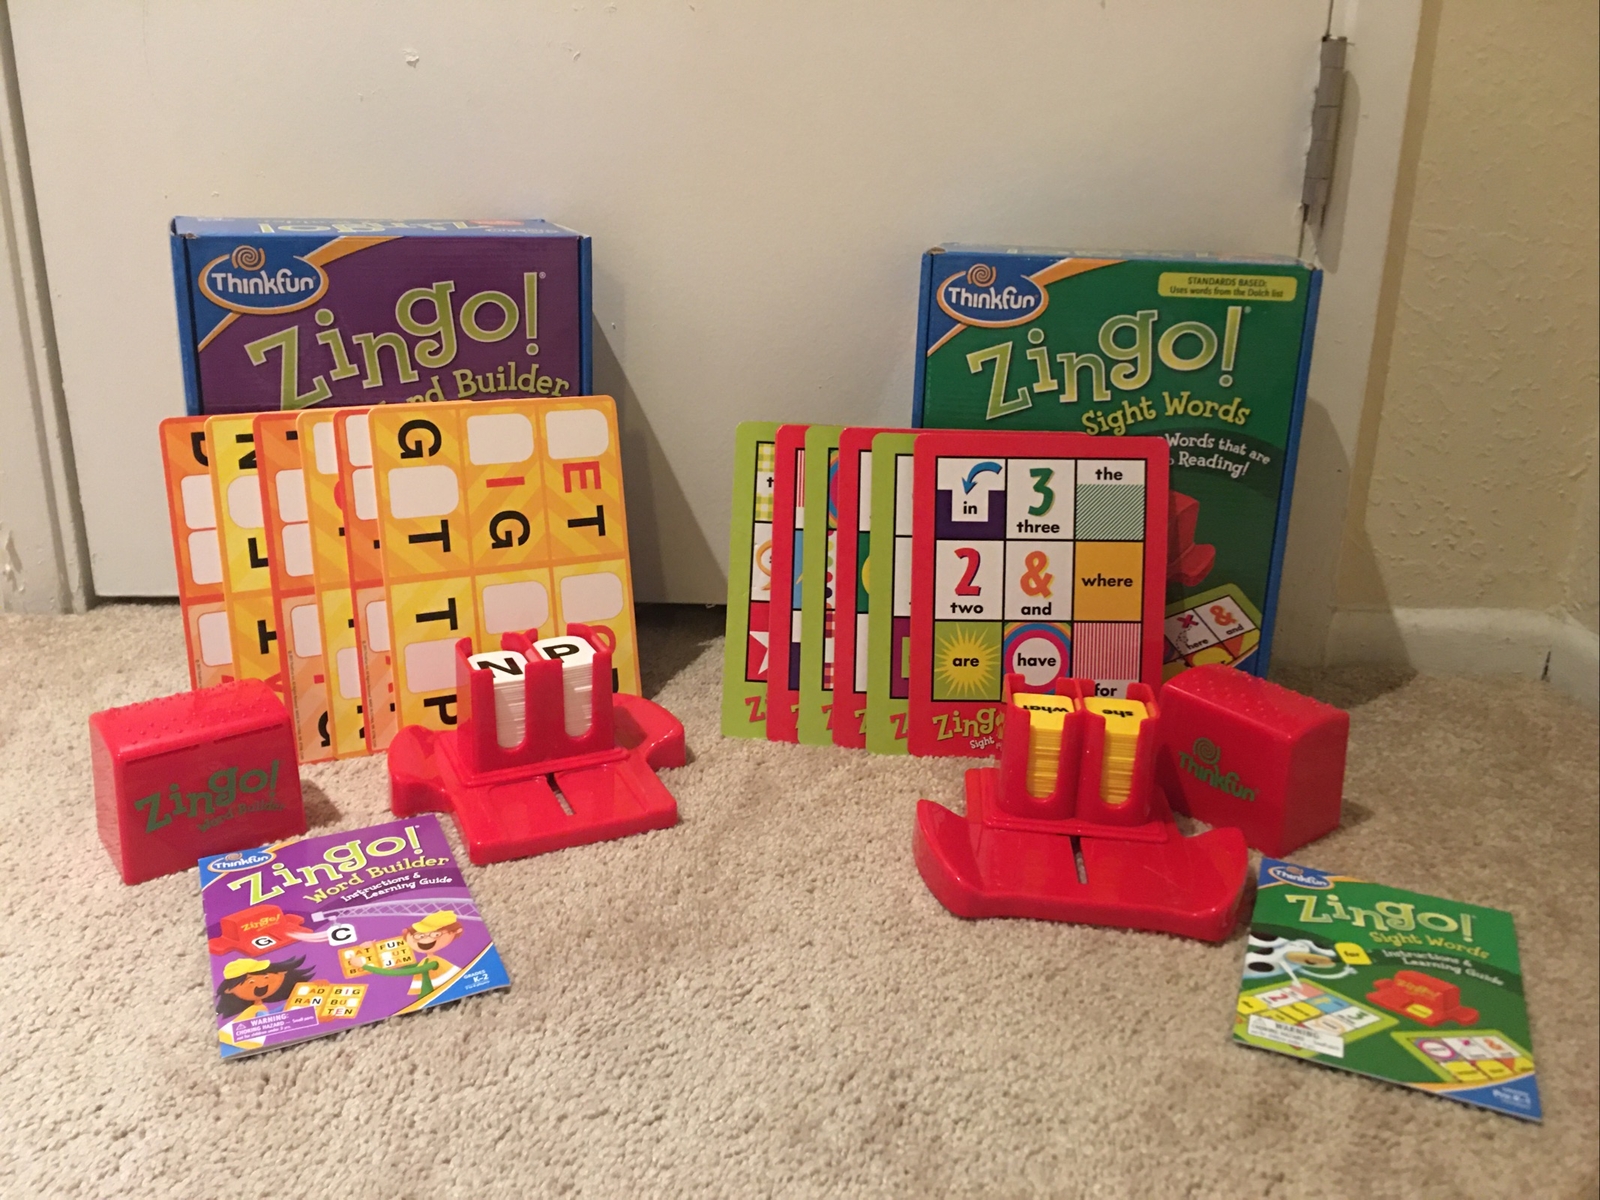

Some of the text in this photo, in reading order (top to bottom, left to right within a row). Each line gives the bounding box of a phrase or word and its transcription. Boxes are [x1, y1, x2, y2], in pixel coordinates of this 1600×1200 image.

[1187, 276, 1237, 287] STANDARDS
[1169, 285, 1188, 295] Uses
[1189, 286, 1212, 296] words
[1213, 286, 1232, 296] from
[1233, 287, 1245, 297] the
[1271, 288, 1284, 298] list
[244, 271, 540, 411] Zingo!
[966, 305, 1243, 421] Zingo!
[452, 361, 570, 398] Builder
[1081, 391, 1252, 437] Sight Words
[397, 418, 442, 459] G
[1164, 432, 1271, 465] Words that are
[1095, 467, 1123, 482] the
[1177, 451, 1251, 479] Reading!
[1027, 467, 1054, 517] 3
[962, 500, 978, 516] in
[408, 519, 452, 552] T
[1016, 519, 1060, 534] three
[953, 546, 982, 597] 2
[1081, 572, 1133, 588] where
[415, 597, 458, 631] T
[950, 602, 984, 616] two
[1020, 601, 1052, 617] and
[1225, 623, 1245, 636] and
[1185, 638, 1210, 651] here
[952, 655, 980, 669] are
[1016, 653, 1057, 668] have
[1094, 682, 1118, 697] for
[931, 707, 1004, 741] Zing
[969, 735, 995, 750] Sight
[133, 758, 280, 834] Zingo!
[226, 825, 423, 907] Zingo!
[302, 856, 450, 904] Word Builder
[340, 874, 411, 903] Instructions
[361, 875, 453, 900] Learning Guide
[241, 913, 281, 932] Zingo!
[1285, 893, 1474, 943] Zingo!
[254, 937, 273, 947] G
[330, 927, 352, 942] C
[379, 940, 405, 951] FUN
[1369, 930, 1490, 960] Sight Words
[1381, 948, 1461, 966] Instructions
[1402, 956, 1505, 987] Learning Guide
[334, 988, 361, 996] BIG
[327, 1007, 353, 1016] TEN
